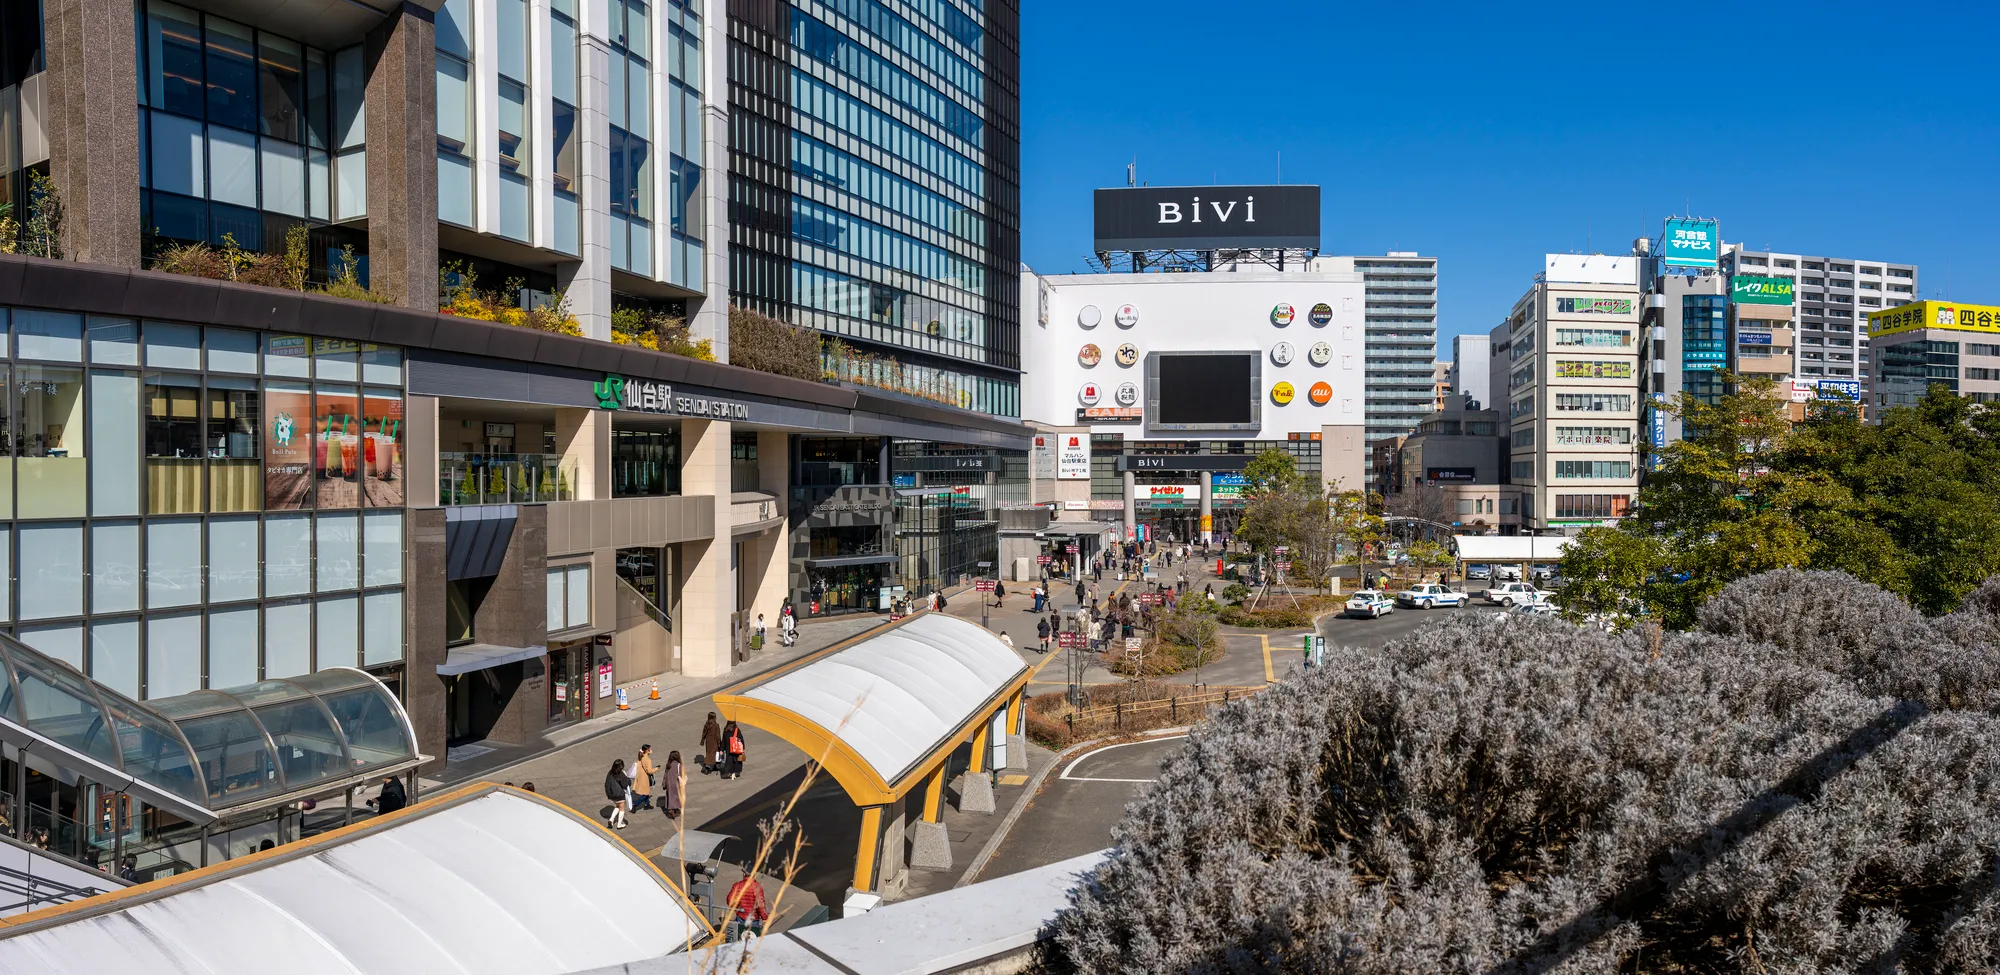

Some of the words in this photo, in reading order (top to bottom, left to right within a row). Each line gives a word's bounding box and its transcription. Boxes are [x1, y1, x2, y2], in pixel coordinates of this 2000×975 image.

[1157, 196, 1256, 224] BiVi
[1675, 229, 1707, 240] 河合塾
[1671, 240, 1711, 250] マナビス
[1734, 282, 1792, 295] レイクALSA
[1882, 307, 1923, 329] 四谷学院
[593, 375, 624, 400] JR
[1820, 382, 1859, 394] 平和住宅
[624, 379, 672, 411] 仙台駅
[677, 396, 712, 415] SENDAI
[712, 401, 749, 419] STATION
[1085, 408, 1142, 417] GAME
[1654, 394, 1664, 463] 仙駅東クリニク
[1556, 435, 1611, 444] アポロ音楽院
[1138, 457, 1164, 466] BiVi
[267, 466, 303, 475] タピオカ専門店
[1150, 486, 1184, 494] サイゼリヤ
